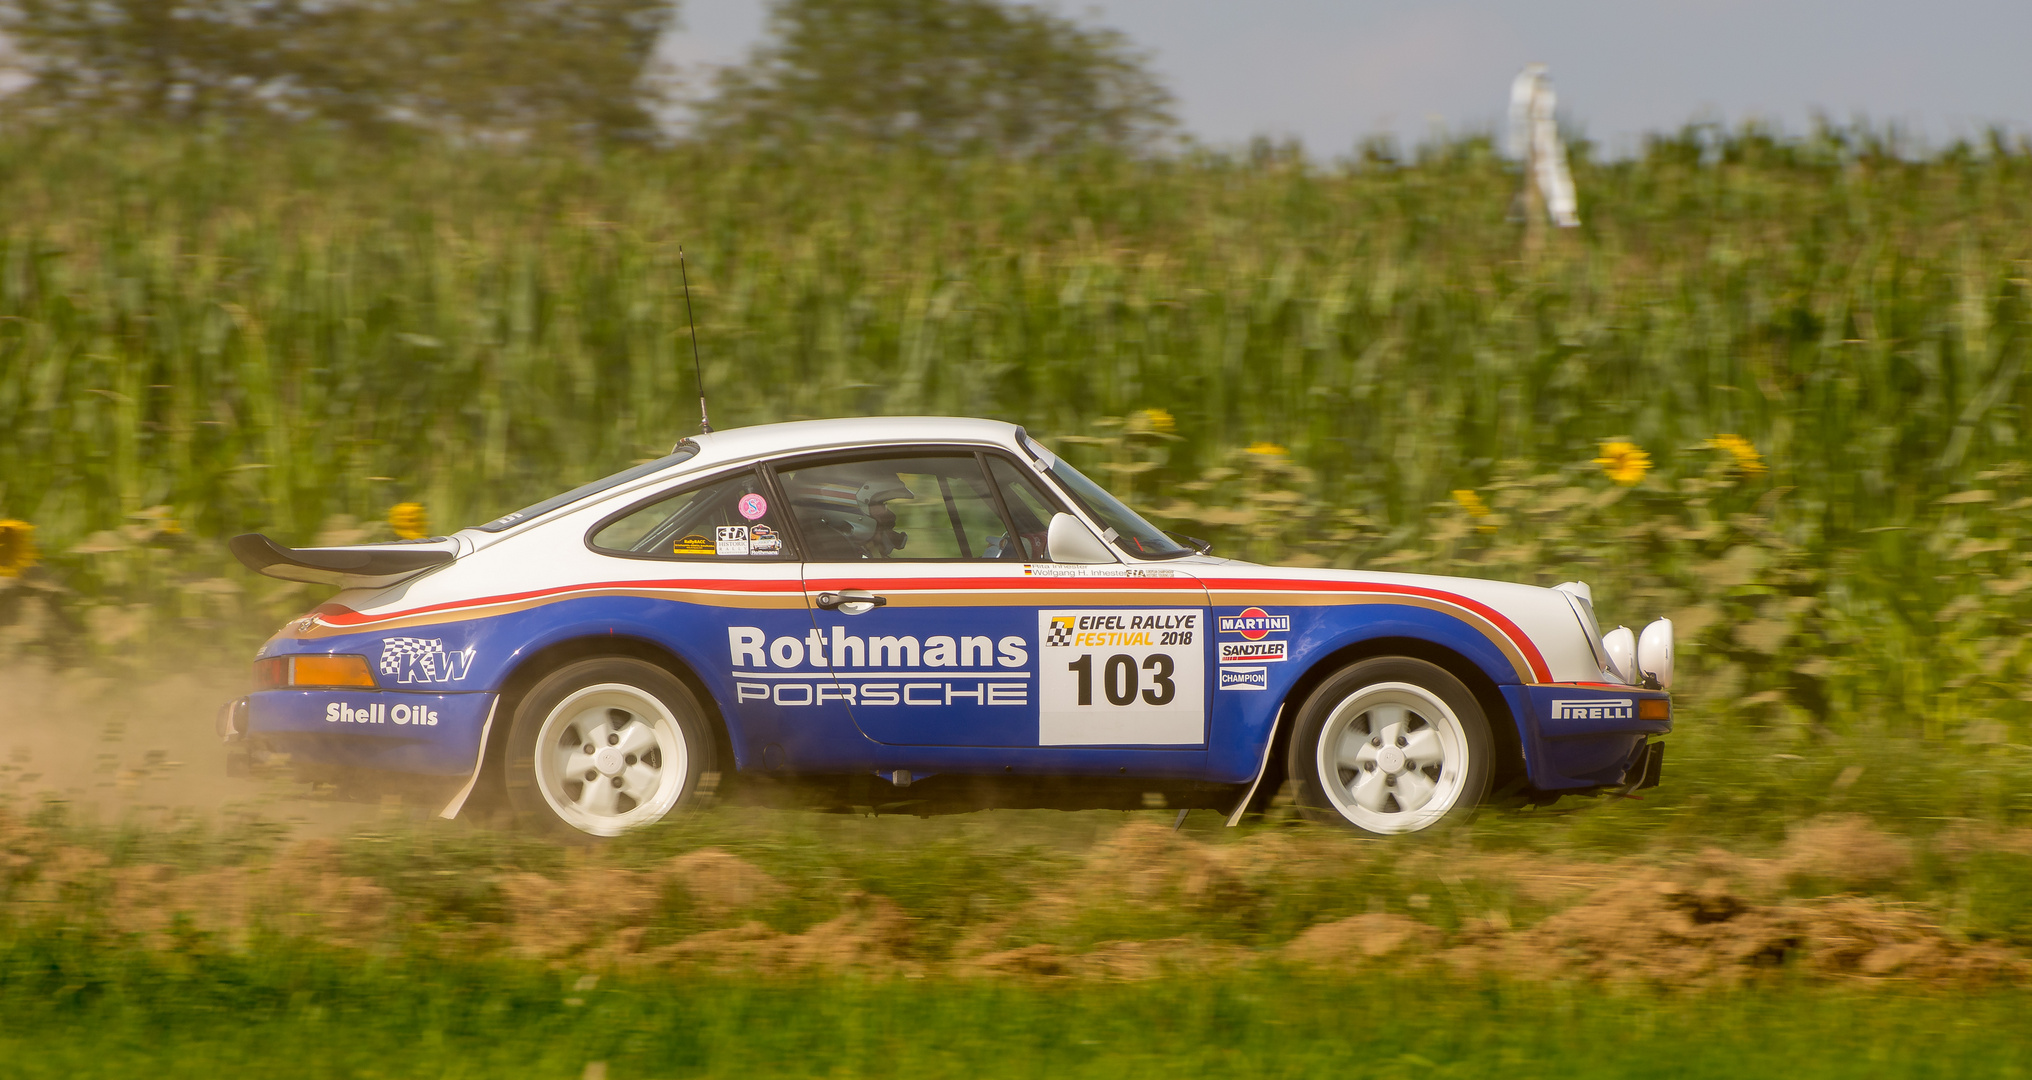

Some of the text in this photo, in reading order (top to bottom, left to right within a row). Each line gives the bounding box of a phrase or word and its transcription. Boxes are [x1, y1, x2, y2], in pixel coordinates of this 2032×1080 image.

[1032, 569, 1076, 578] Wolfgang
[1079, 615, 1197, 630] EIFEL RALLYE
[1221, 618, 1287, 630] MARTINI
[728, 626, 1029, 668] Rothmans
[1075, 631, 1193, 647] FESTIVAL 2018
[1222, 643, 1285, 656] SANDTLER
[397, 650, 477, 684] KW
[1068, 653, 1176, 706] 103
[1221, 674, 1265, 683] CHAMPION
[736, 682, 1028, 706] PORSCHE
[325, 702, 439, 726] Shell Oils
[1551, 698, 1633, 720] PIRELLI
